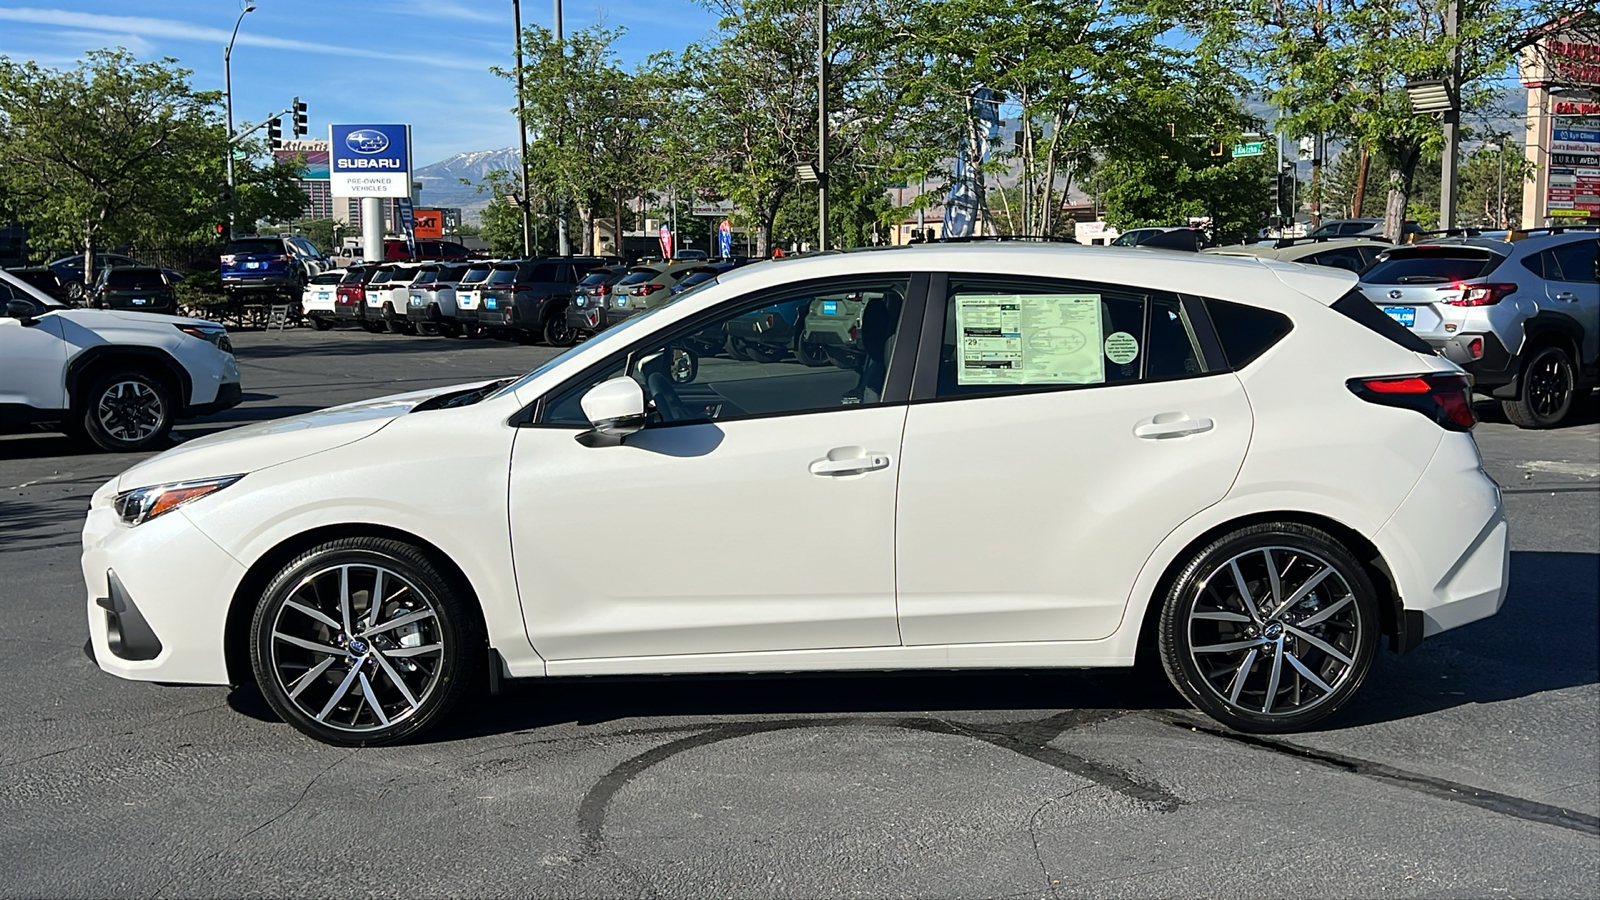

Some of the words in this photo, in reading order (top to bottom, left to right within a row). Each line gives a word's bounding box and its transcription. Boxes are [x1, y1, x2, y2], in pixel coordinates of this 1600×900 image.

[1580, 132, 1595, 140] Clinic
[283, 140, 328, 152] Atlantis
[338, 158, 400, 168] SUBARU
[1553, 155, 1575, 164] AURA
[1579, 156, 1598, 165] AVEDA
[968, 338, 978, 346] 29
